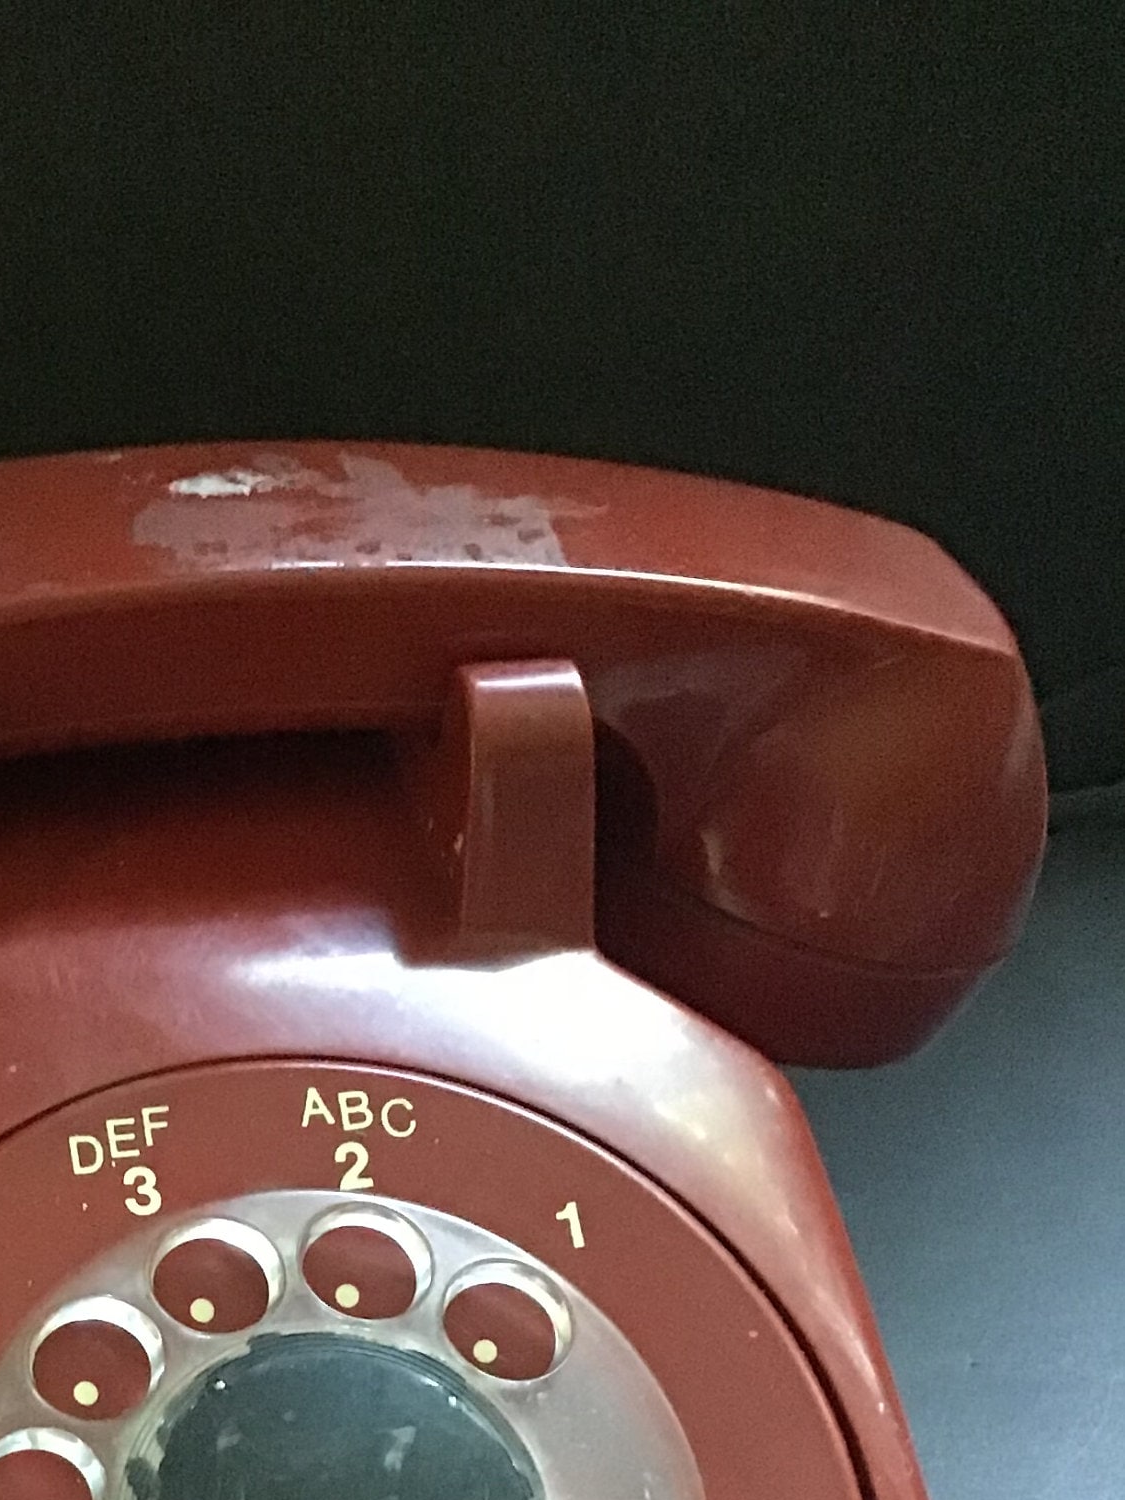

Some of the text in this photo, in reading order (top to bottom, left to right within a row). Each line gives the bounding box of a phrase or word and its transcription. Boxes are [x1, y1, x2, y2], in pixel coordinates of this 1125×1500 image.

[301, 1086, 417, 1138] ABC
[68, 1105, 170, 1176] DEF
[123, 1165, 163, 1216] 3
[334, 1142, 374, 1191] 2
[555, 1201, 586, 1249] 1
